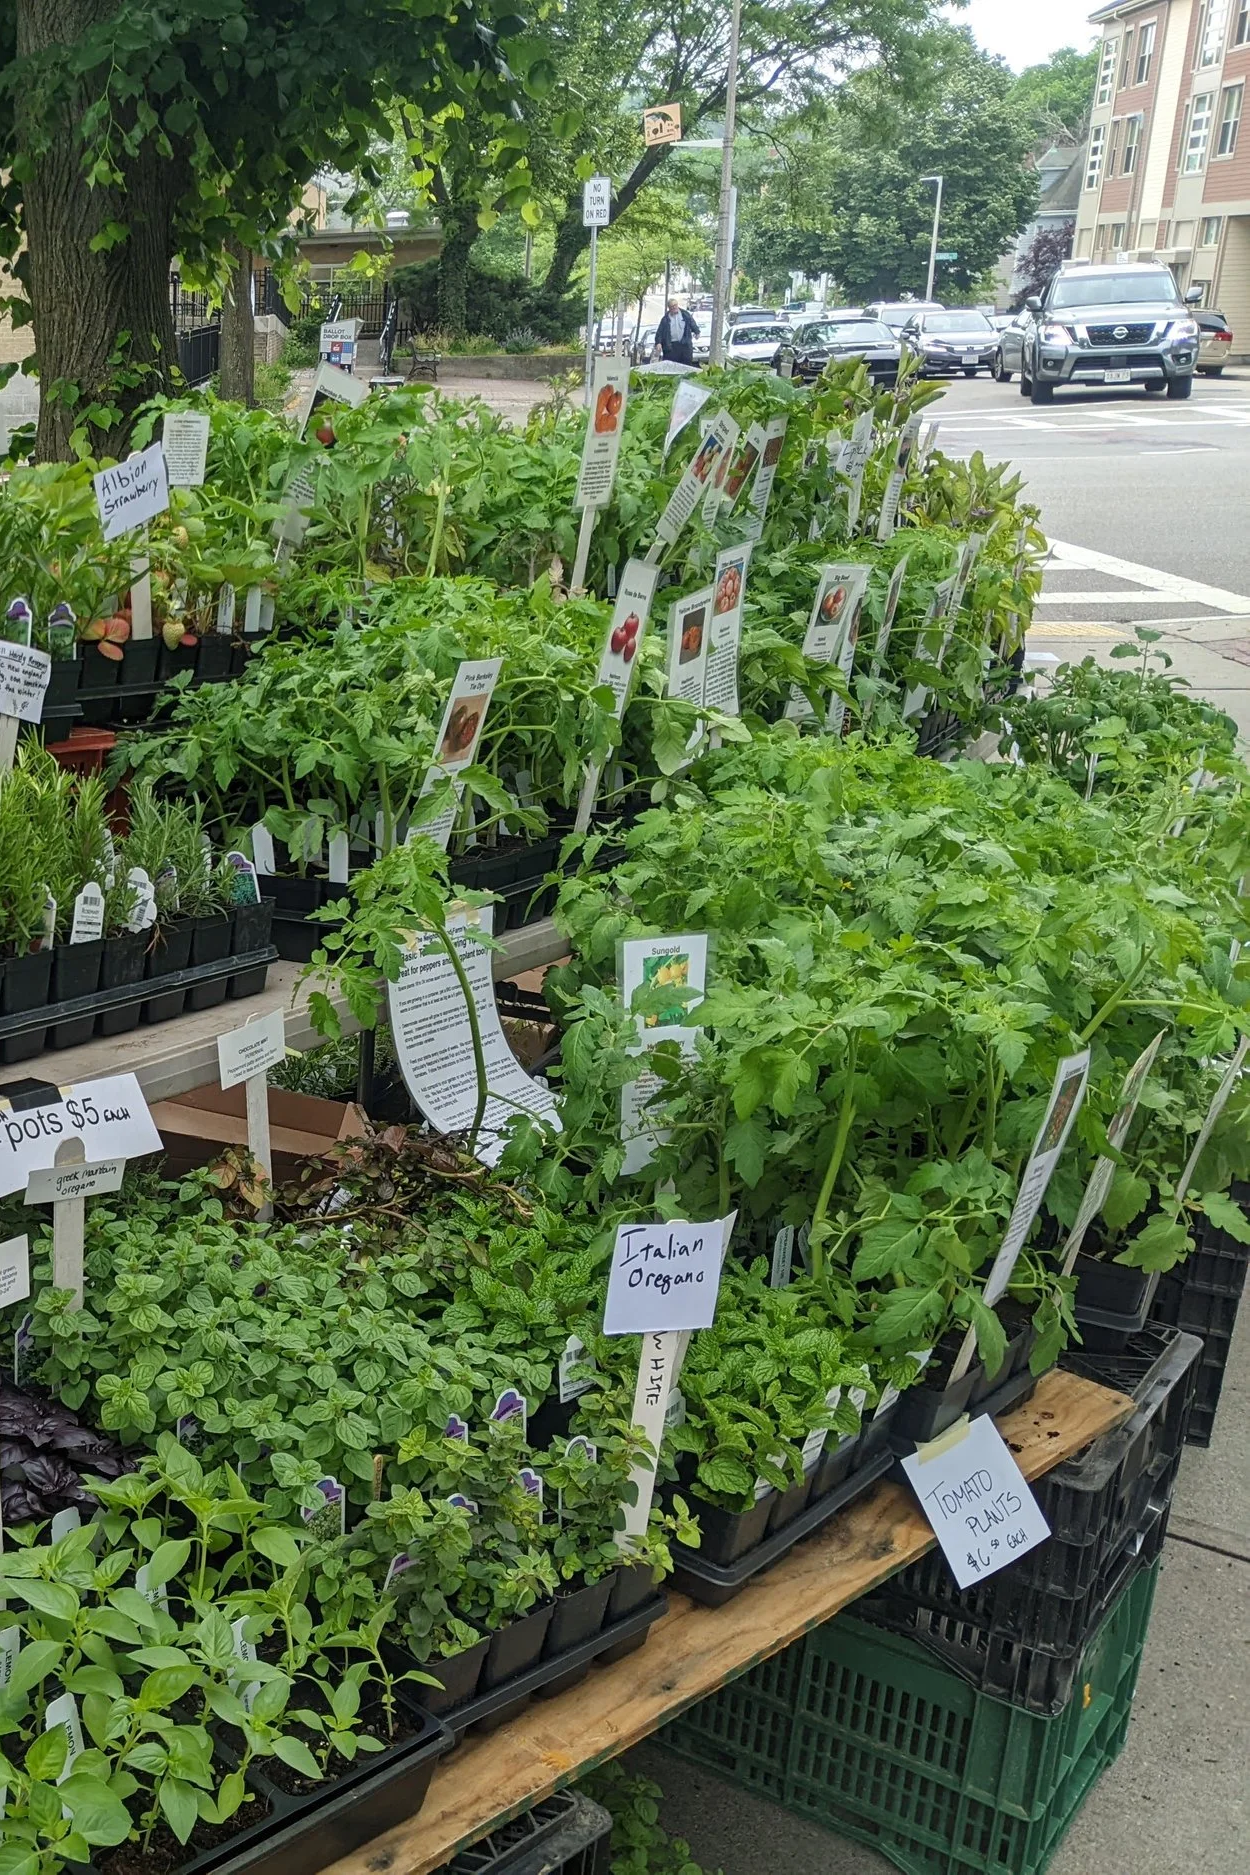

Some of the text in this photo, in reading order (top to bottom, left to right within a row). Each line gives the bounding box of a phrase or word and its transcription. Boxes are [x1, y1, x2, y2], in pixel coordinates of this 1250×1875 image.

[593, 184, 601, 192] NO
[596, 210, 607, 218] RED
[102, 459, 148, 498] Albion
[104, 478, 160, 515] Strawberry
[8, 664, 20, 673] new
[464, 674, 475, 682] Pink
[651, 946, 681, 955] Sungold
[419, 960, 440, 974] peppers
[66, 1097, 100, 1131] $5
[104, 1107, 131, 1123] EACH
[61, 1180, 96, 1196] oregano
[619, 1227, 703, 1267] Italian
[628, 1268, 704, 1295] Oregano
[925, 1470, 993, 1520] TOMATO
[965, 1492, 1022, 1537] PLANTS
[1007, 1528, 1029, 1549] EACH
[63, 1718, 76, 1757] LEMON
